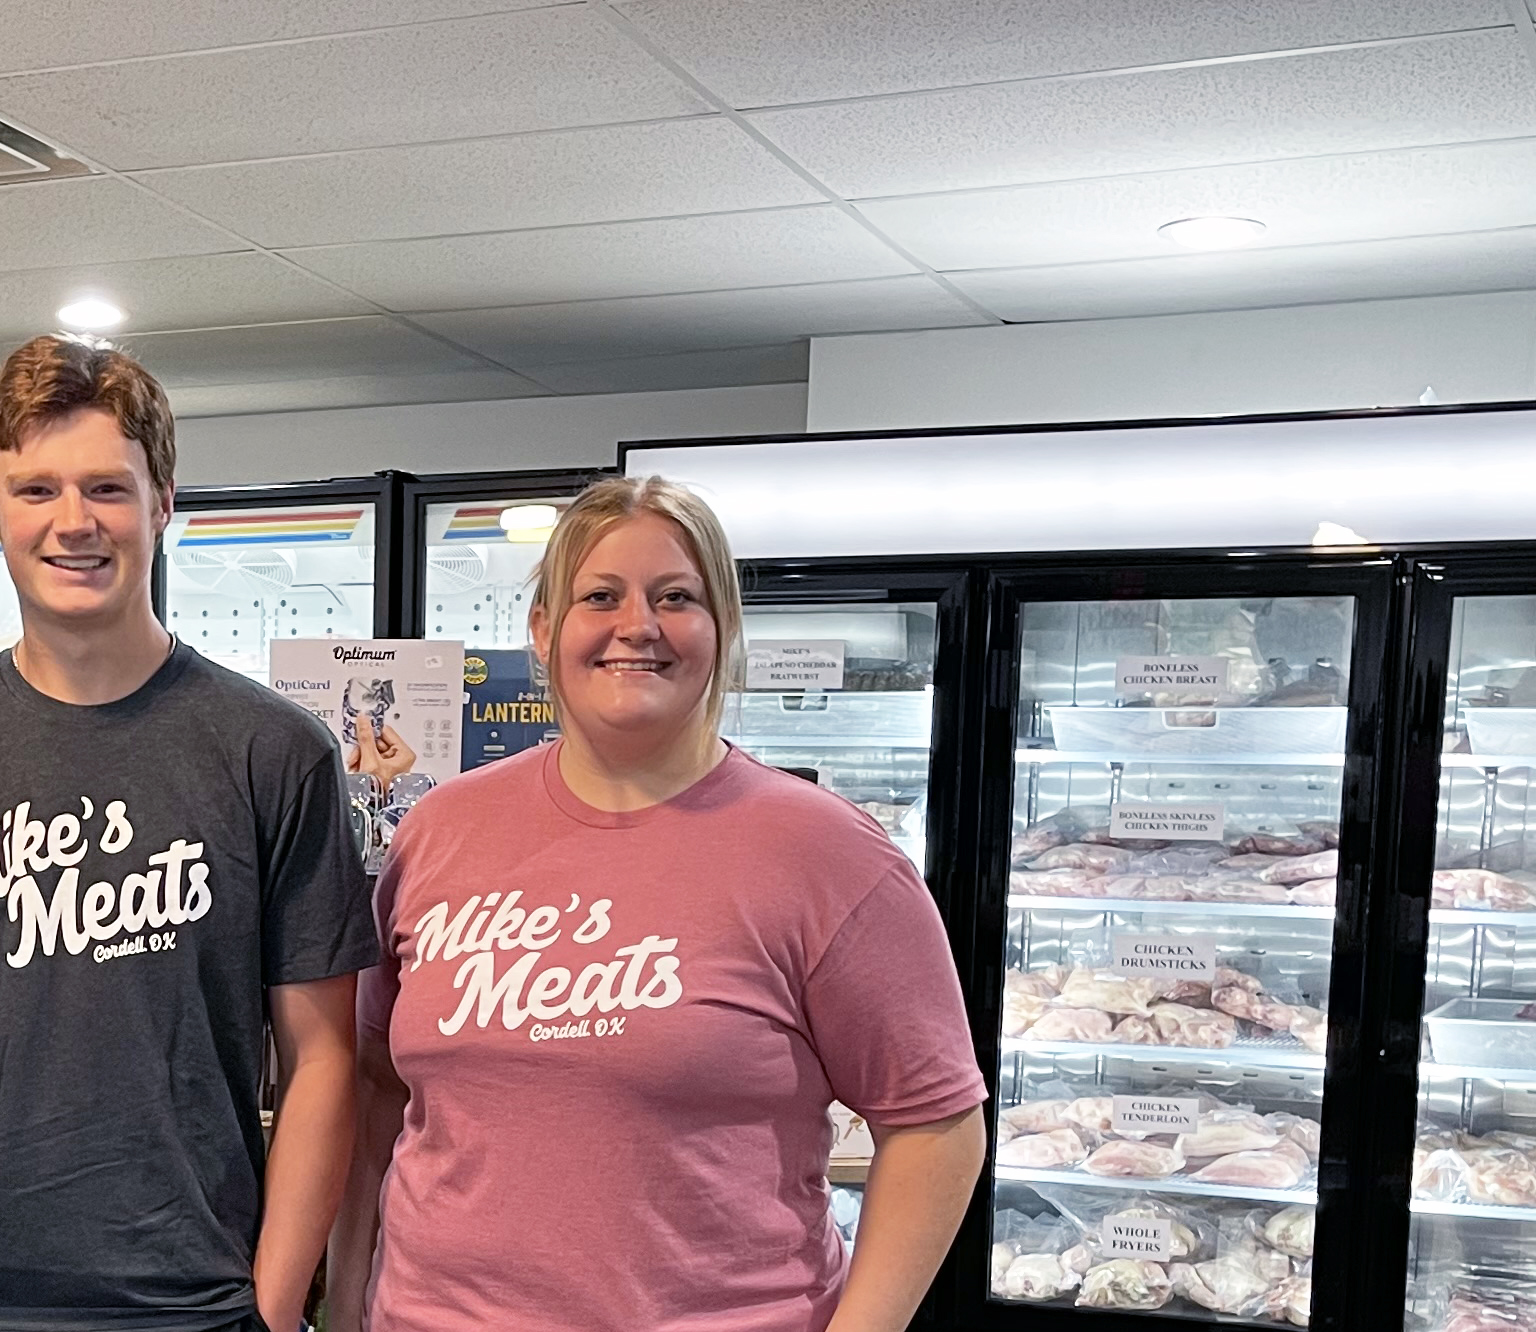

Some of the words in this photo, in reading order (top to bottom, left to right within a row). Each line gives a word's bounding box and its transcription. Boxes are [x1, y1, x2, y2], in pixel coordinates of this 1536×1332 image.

[332, 646, 395, 664] Optimum
[1144, 664, 1199, 672] BONELESS
[275, 680, 330, 692] OptiCard
[1124, 676, 1173, 684] CHICKEN
[1176, 676, 1218, 684] BREAST
[472, 702, 555, 723] LANTERN
[1169, 813, 1216, 821] SKINLESS
[1125, 822, 1169, 830] CHICKEN
[1172, 823, 1208, 831] THIGHS
[6, 839, 212, 968] Meats
[411, 890, 612, 972] Mike's
[93, 939, 147, 963] Cordell
[149, 931, 176, 951] OK
[1134, 944, 1194, 955] CHICKEN
[1121, 957, 1206, 970] DRUMSTICKS
[438, 935, 683, 1036] Meats
[529, 1020, 590, 1042] Cordell
[594, 1017, 626, 1036] OK
[1131, 1102, 1180, 1112] CHICKEN
[1121, 1113, 1190, 1124] TENDERLOIN
[1113, 1226, 1160, 1239] WHOLE
[1112, 1240, 1161, 1252] FRYERS
